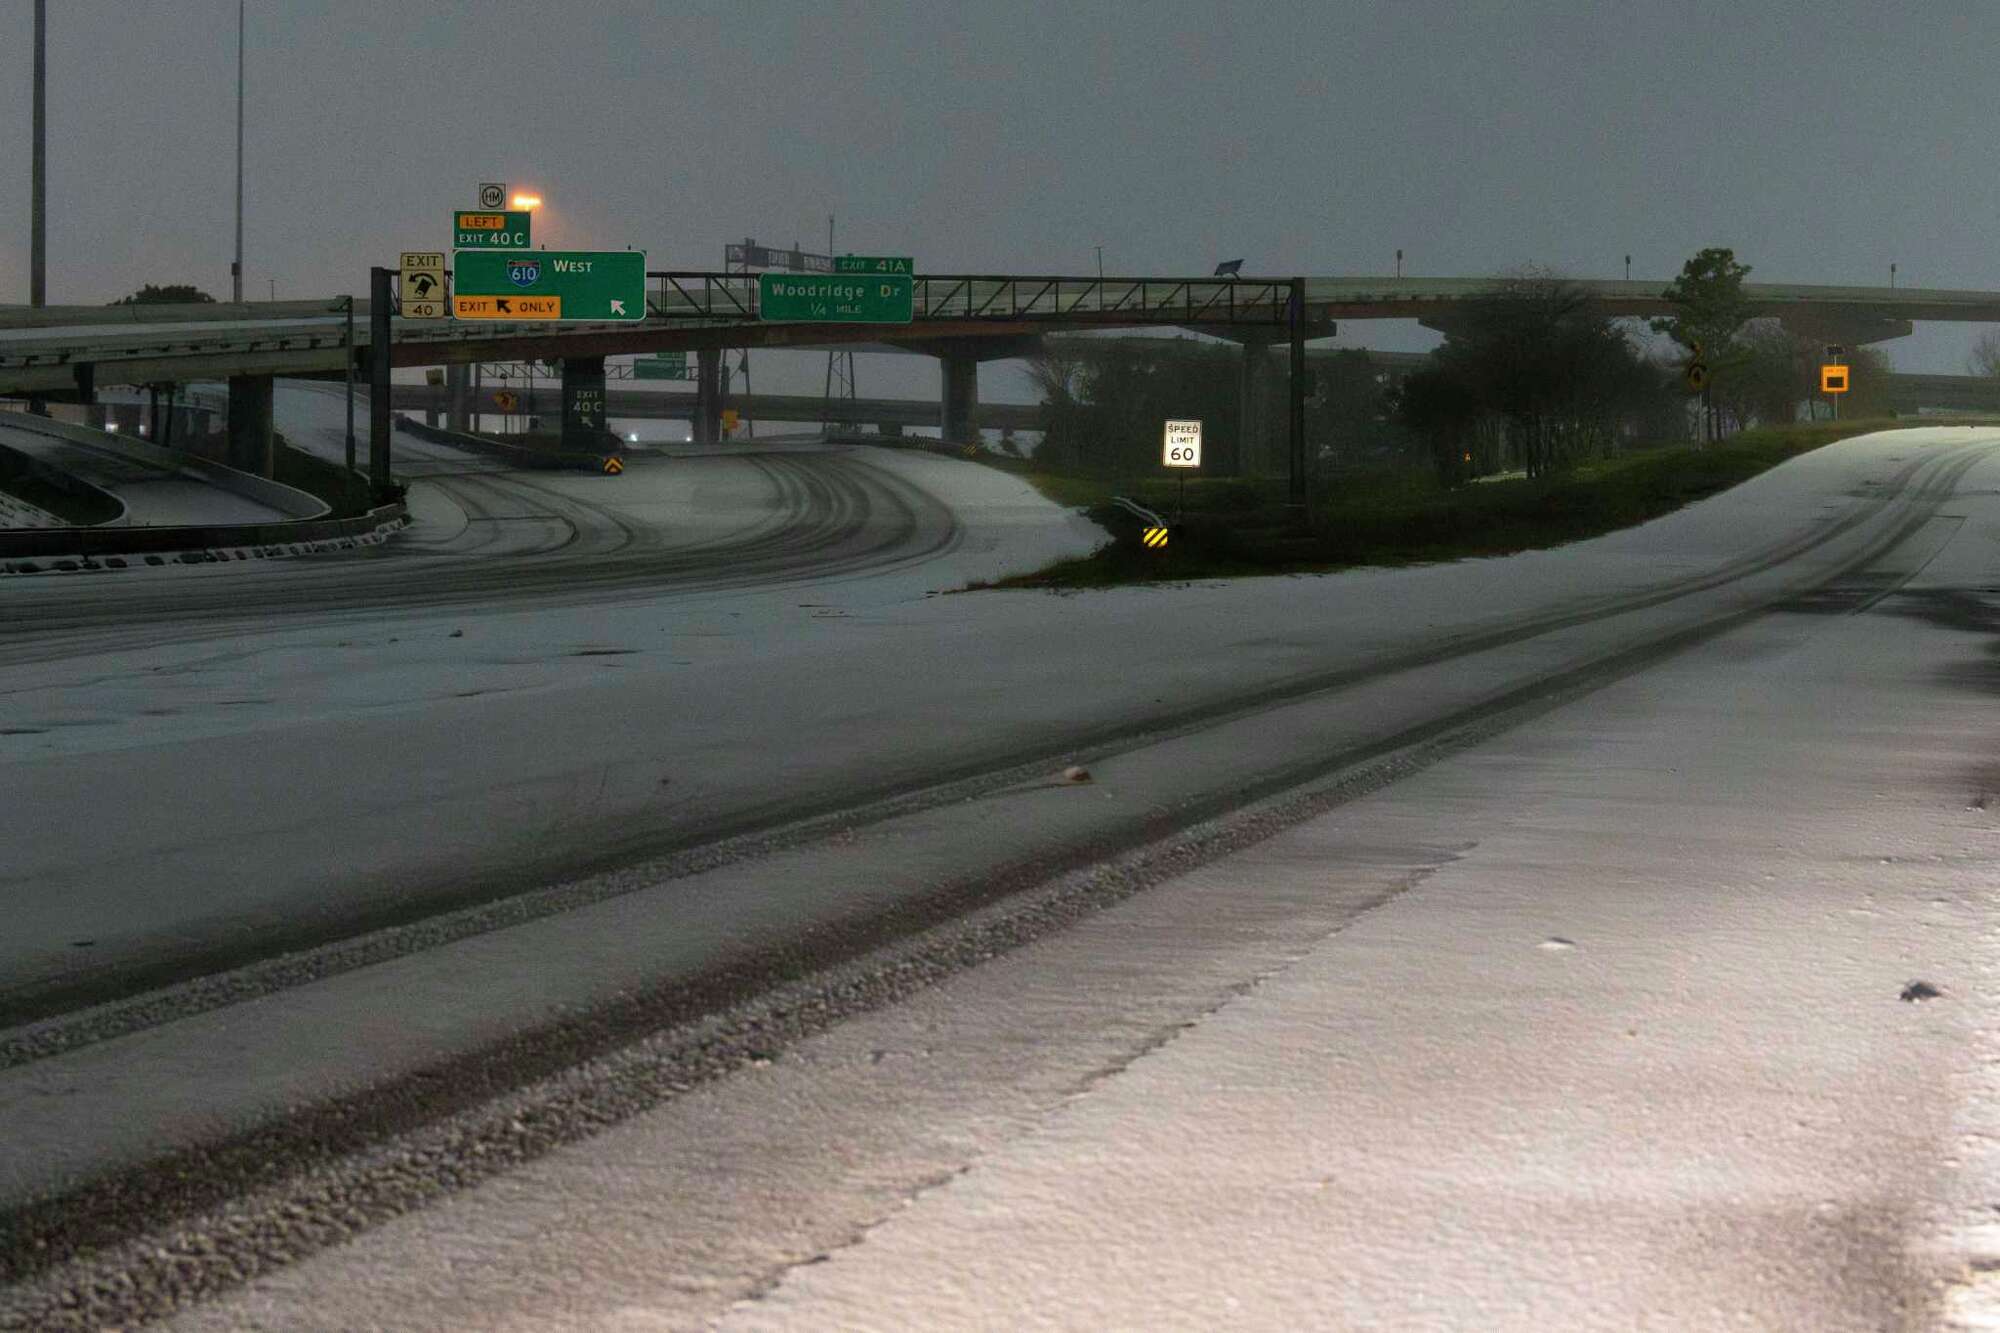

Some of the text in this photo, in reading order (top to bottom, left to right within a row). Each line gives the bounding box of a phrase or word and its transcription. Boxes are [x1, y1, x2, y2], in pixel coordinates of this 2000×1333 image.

[485, 191, 501, 202] HM
[466, 216, 497, 227] LEFT
[459, 233, 484, 243] EXIT
[406, 255, 439, 266] EXIT
[841, 259, 906, 273] EXIT 41A
[512, 267, 537, 281] 610
[771, 283, 901, 301] Woodridge Dr
[413, 304, 433, 316] 40
[459, 301, 555, 313] EXIT ONLY
[836, 304, 862, 314] MILE
[1167, 424, 1199, 433] SPEED
[1171, 447, 1194, 461] 60
